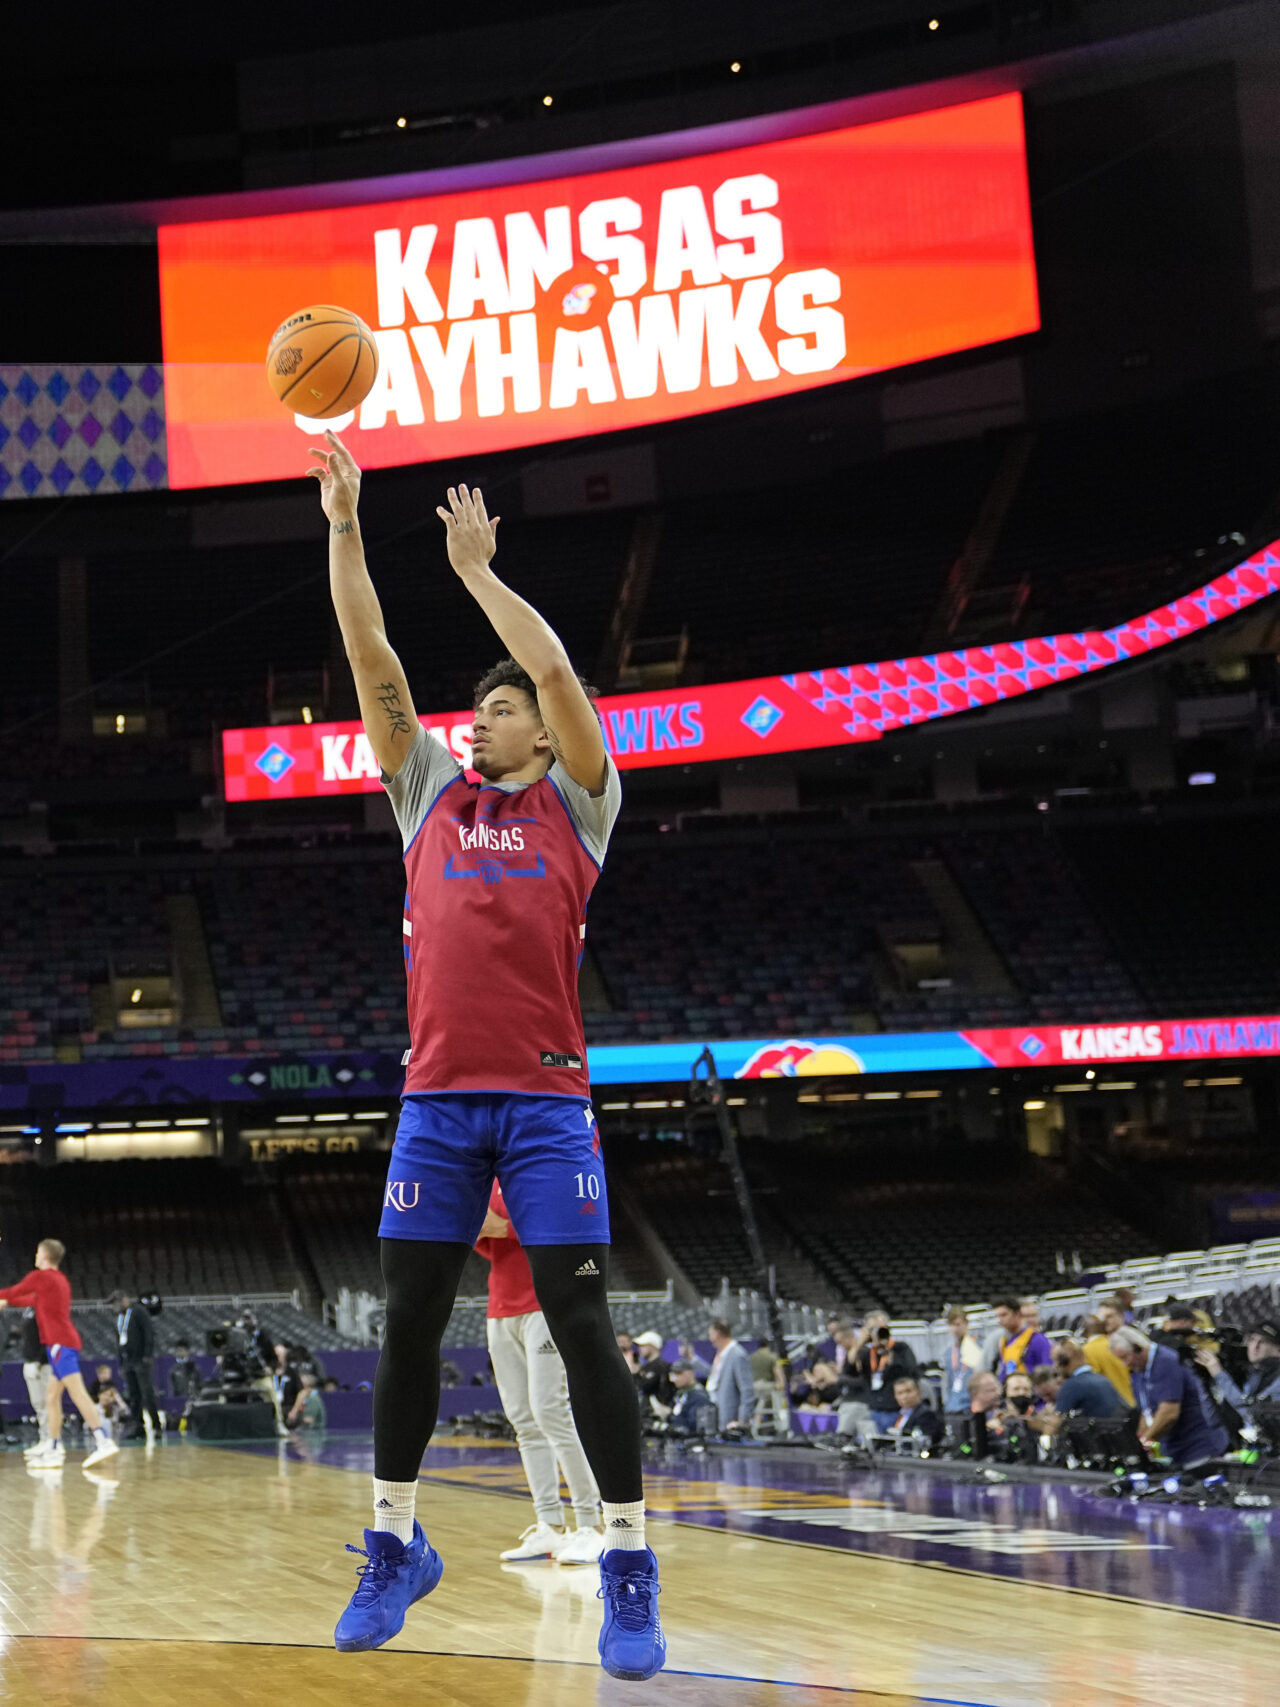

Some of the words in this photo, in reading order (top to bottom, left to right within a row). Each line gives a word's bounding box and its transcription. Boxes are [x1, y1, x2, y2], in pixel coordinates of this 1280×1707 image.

[373, 173, 784, 328] KANSAS
[294, 267, 847, 436] AYHAWKS
[375, 682, 411, 742] FEAR
[321, 723, 474, 781] KAS
[458, 822, 525, 851] KANSAS
[1060, 1025, 1163, 1060] KANSAS
[270, 1064, 334, 1090] NOLA
[384, 1181, 421, 1212] KU
[574, 1172, 600, 1200] 10
